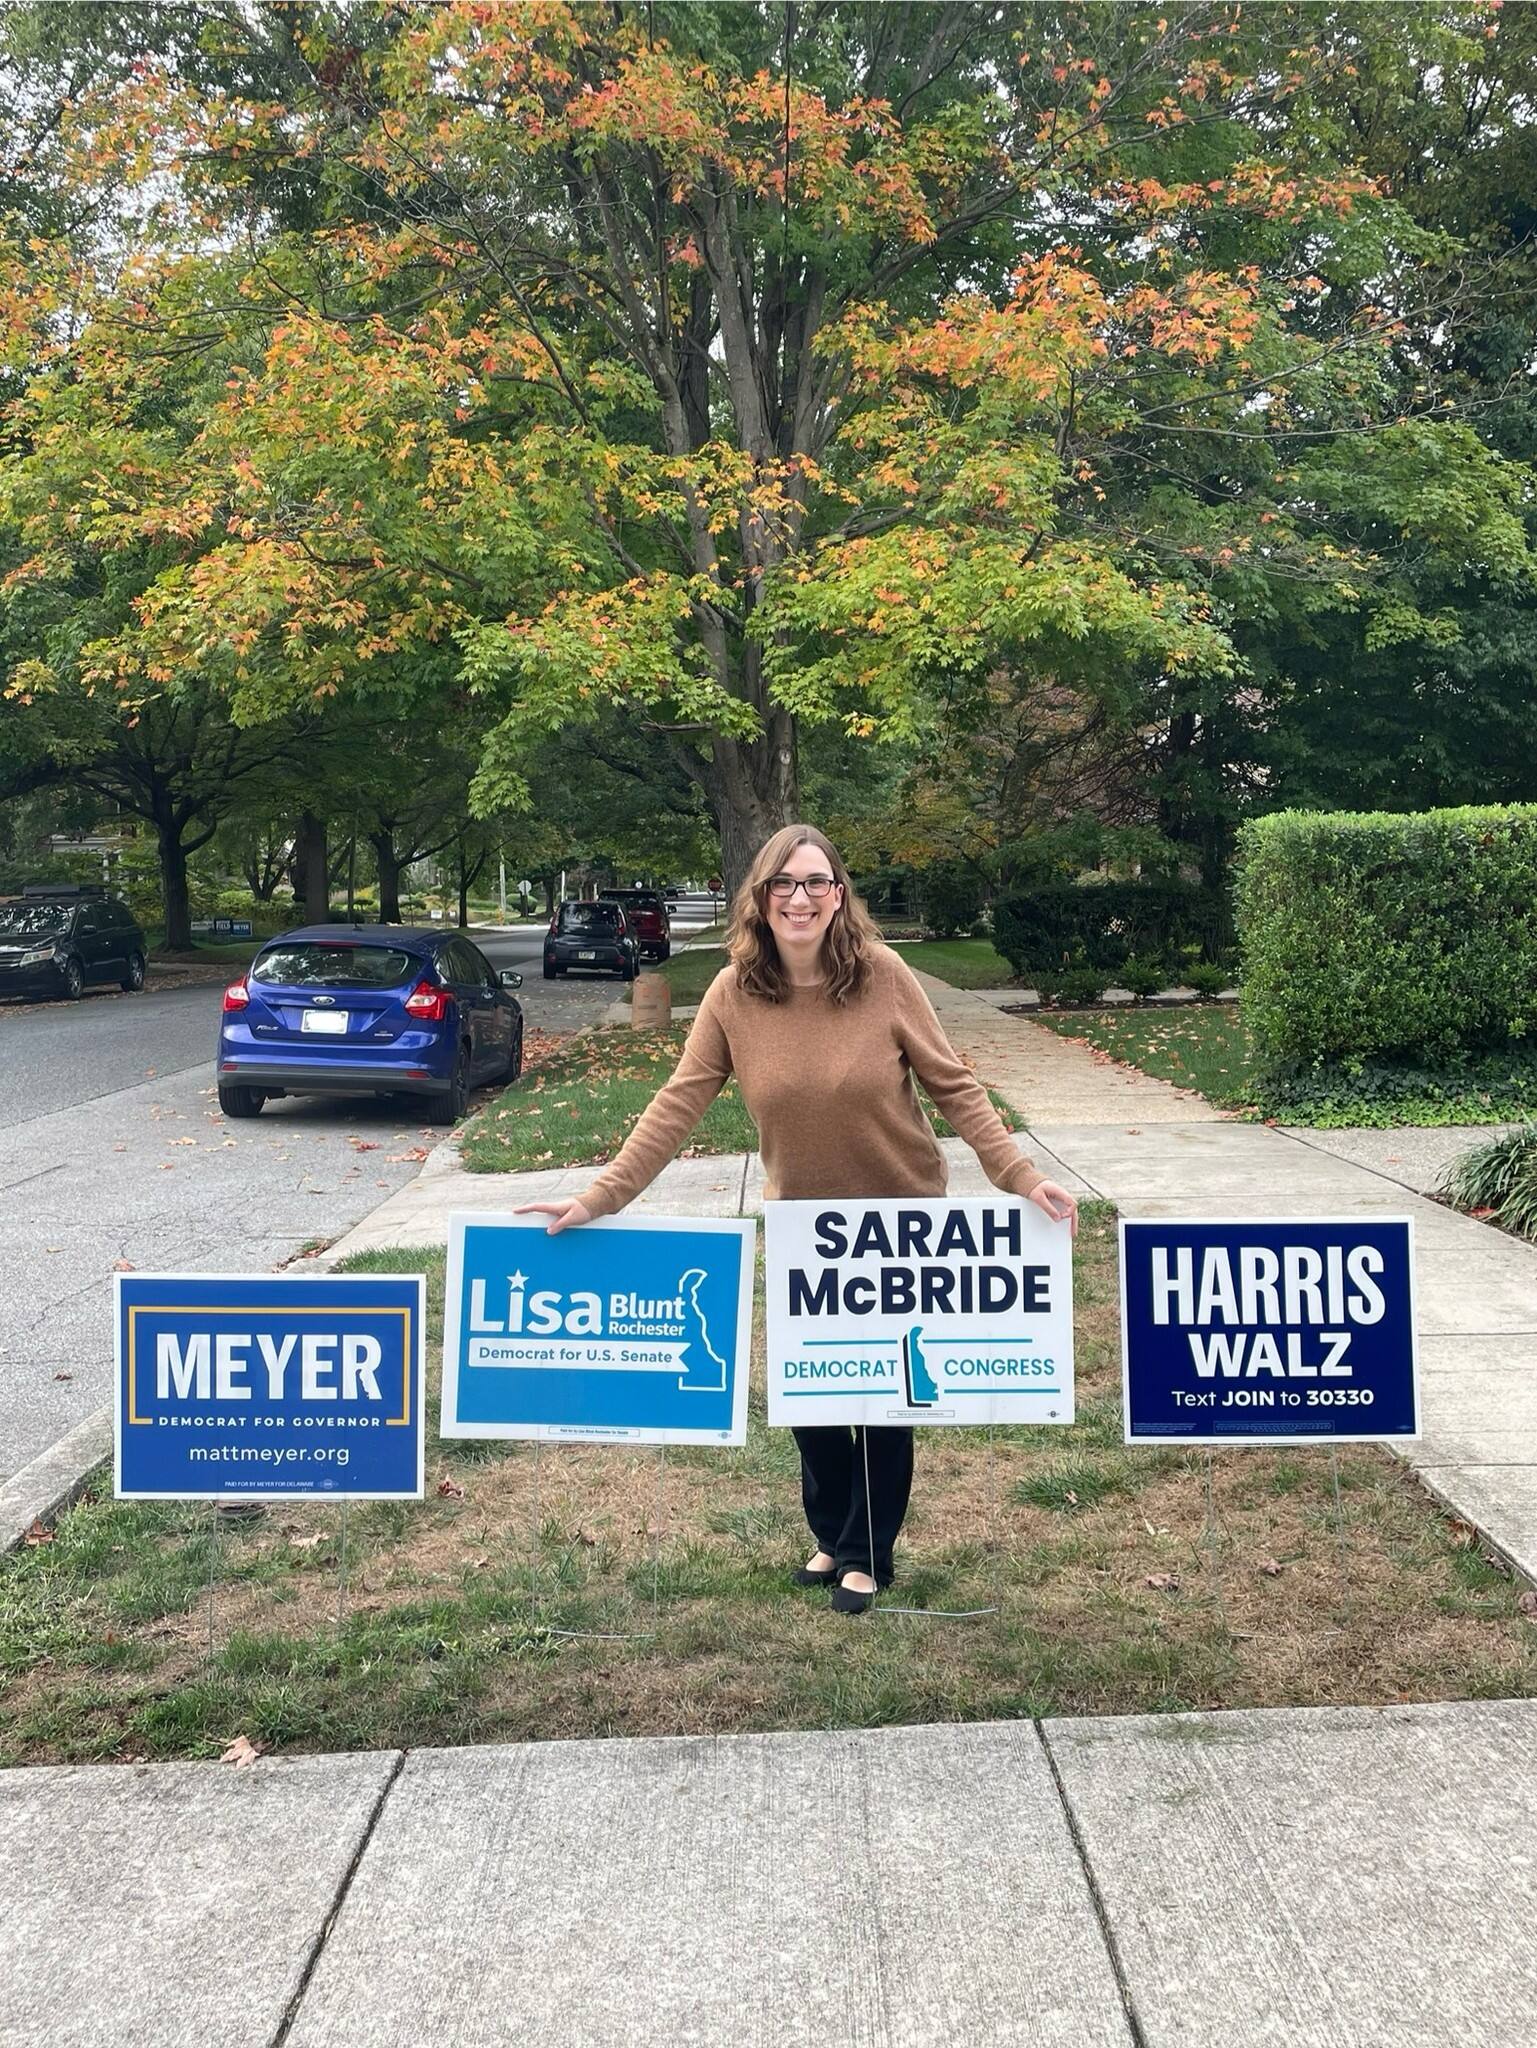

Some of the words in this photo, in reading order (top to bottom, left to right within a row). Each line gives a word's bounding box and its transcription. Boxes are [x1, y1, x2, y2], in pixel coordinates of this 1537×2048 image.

[814, 1209, 1021, 1259] SARAH
[788, 1265, 1051, 1316] McBRIDE
[1151, 1245, 1386, 1325] HARRIS
[469, 1268, 603, 1335] Lisa
[608, 1292, 686, 1320] Blunt
[608, 1321, 685, 1336] Rochester
[157, 1333, 382, 1400] MEYER
[479, 1346, 555, 1361] Democrat
[560, 1347, 582, 1361] for
[586, 1349, 615, 1362] U.S.
[620, 1350, 672, 1363] Senate
[784, 1360, 898, 1378] DEMOCRAT
[944, 1358, 1055, 1376] CONGRESS
[1188, 1332, 1353, 1377] WALZ
[1171, 1390, 1217, 1406] Text
[1221, 1390, 1275, 1406] JOIN
[1280, 1391, 1300, 1406] to
[1306, 1389, 1374, 1406] 30330
[158, 1416, 247, 1426] DEMOCRAT
[254, 1416, 285, 1426] FOR
[292, 1416, 381, 1427] GOVERNOR
[189, 1445, 350, 1465] mattmeyer.org
